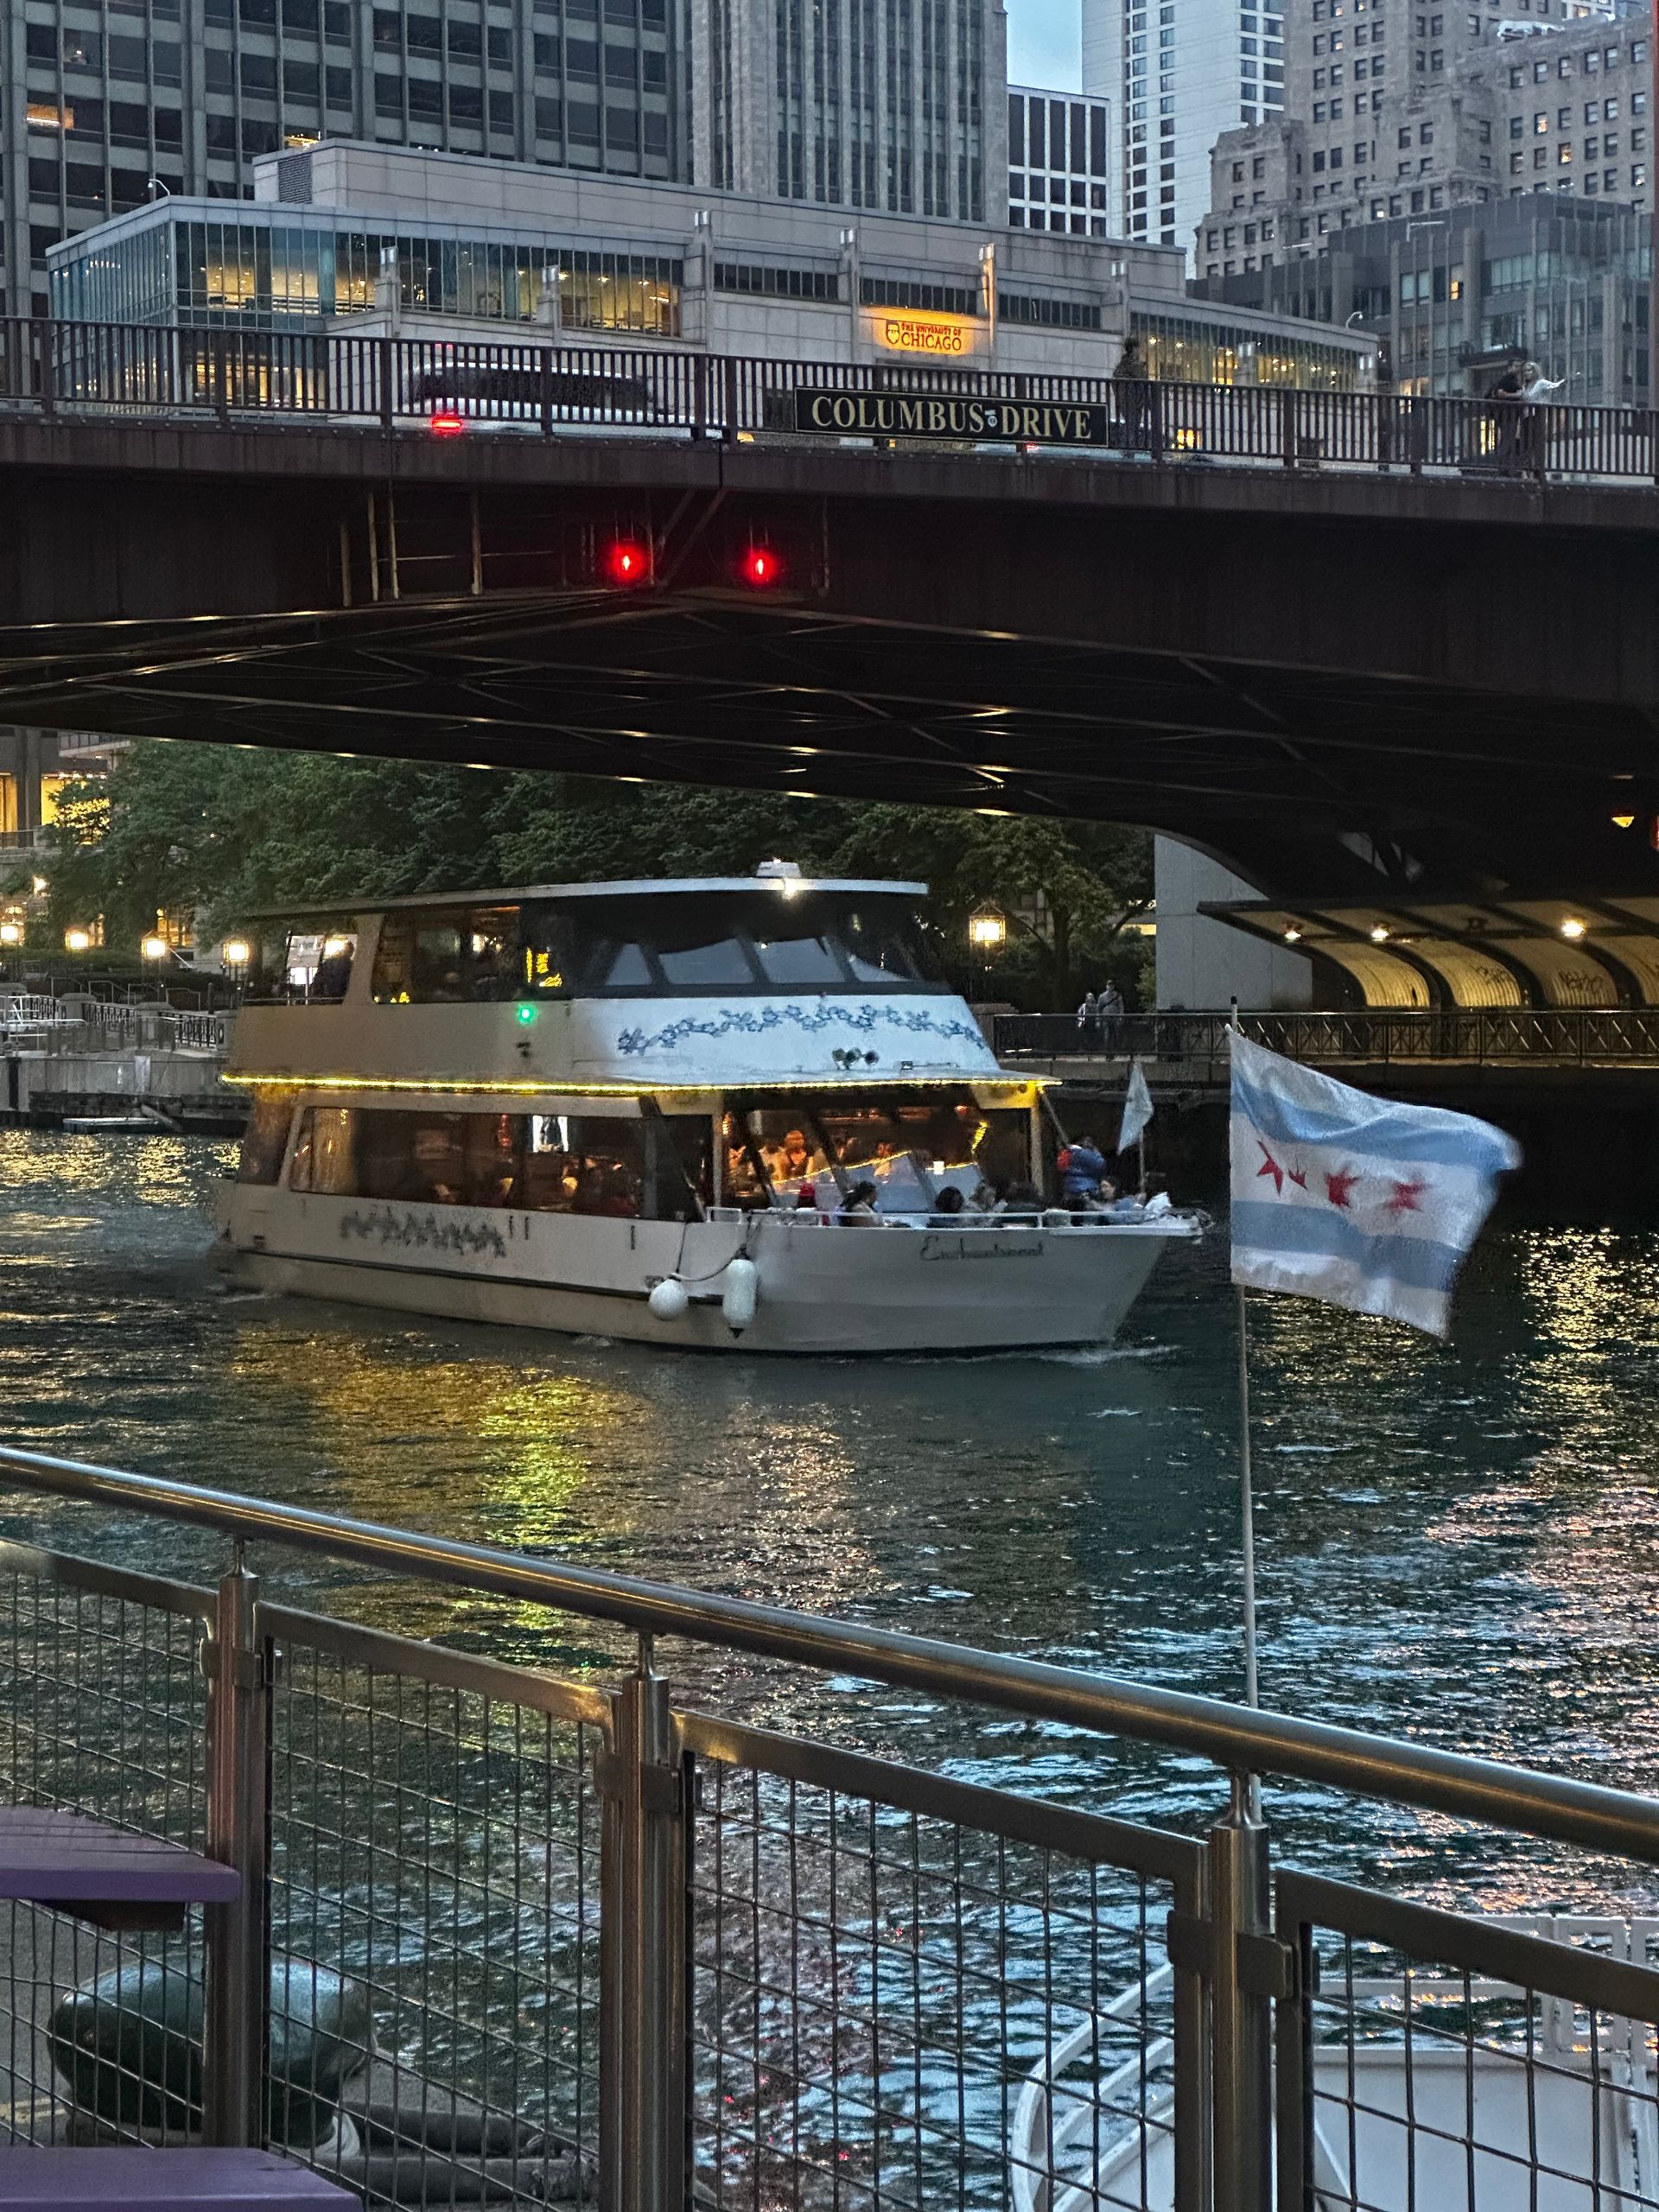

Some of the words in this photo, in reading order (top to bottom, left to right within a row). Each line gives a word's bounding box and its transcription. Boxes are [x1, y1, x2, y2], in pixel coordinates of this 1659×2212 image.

[901, 332, 962, 351] CHICAGO
[811, 395, 985, 433] COLUMBUS
[1000, 404, 1091, 440] DRIVE
